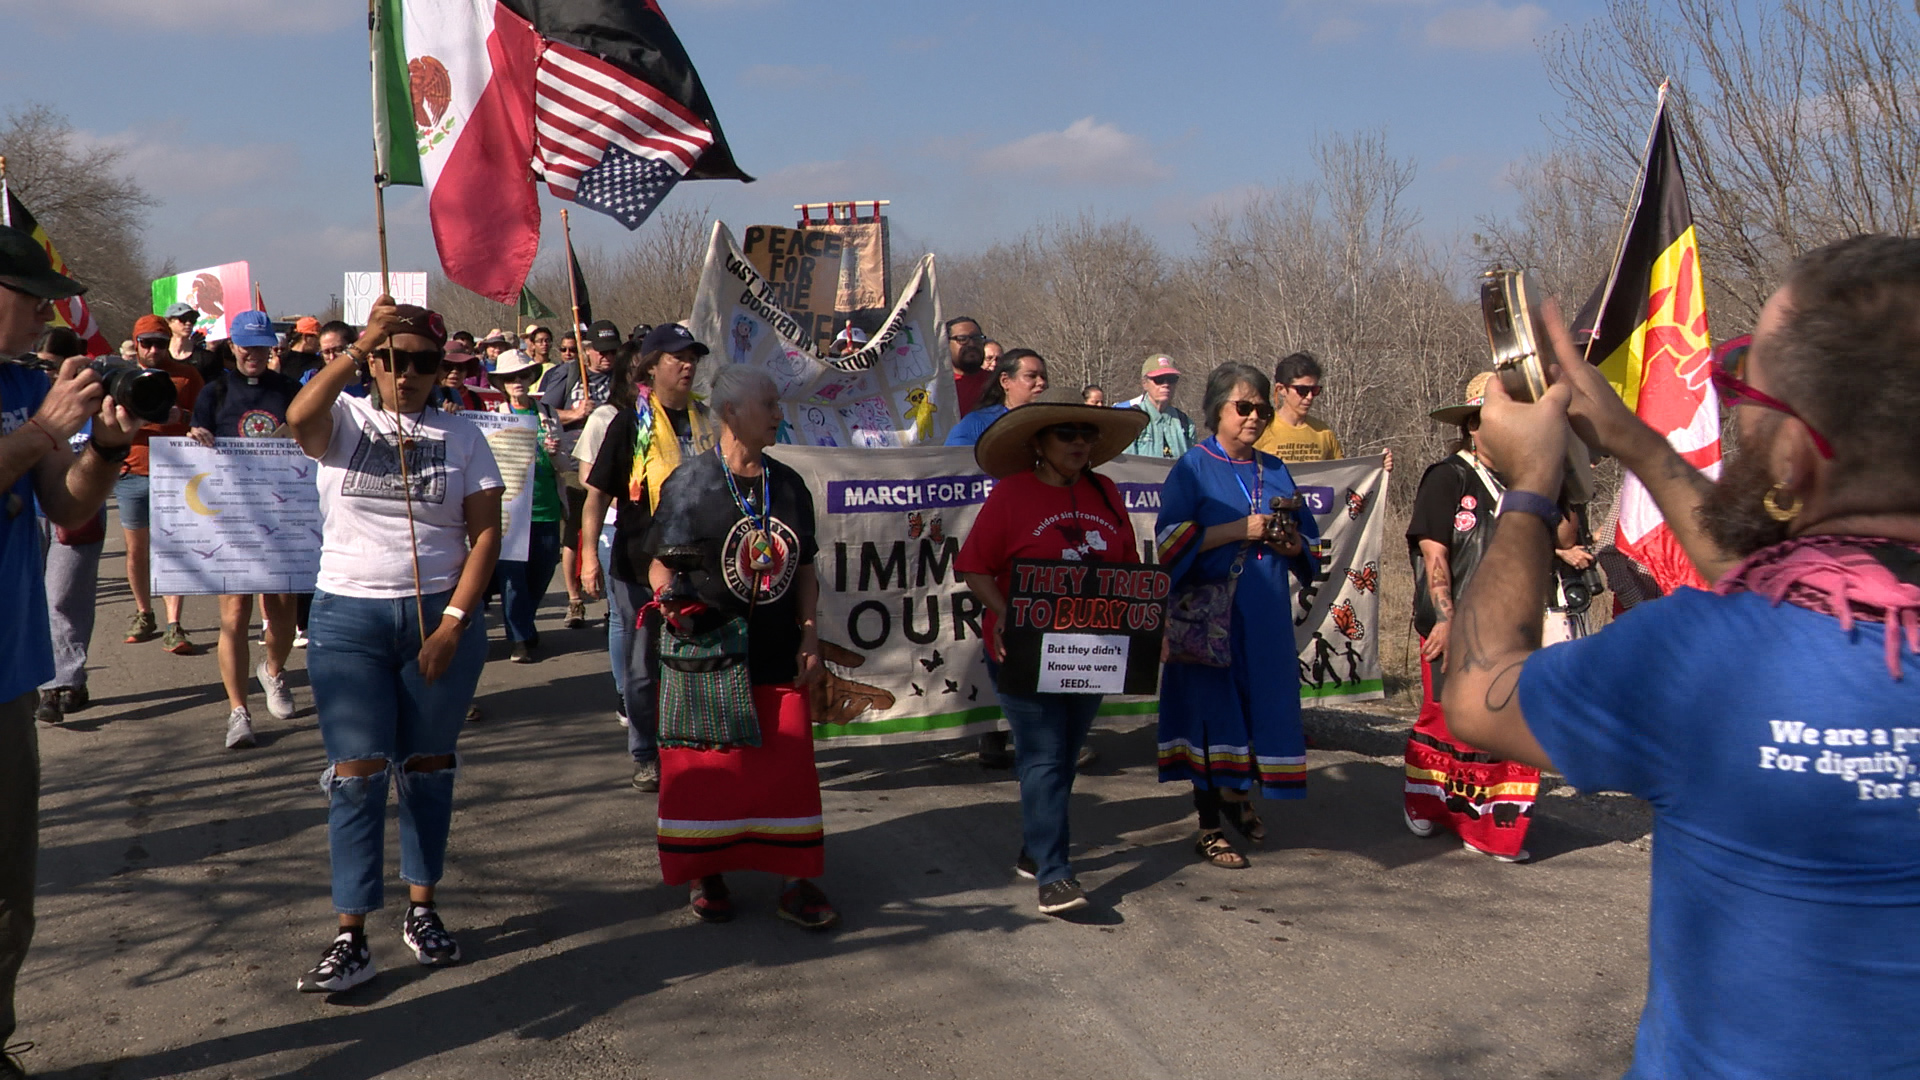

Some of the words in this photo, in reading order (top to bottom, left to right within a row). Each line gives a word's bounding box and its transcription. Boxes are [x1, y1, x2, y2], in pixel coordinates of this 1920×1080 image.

[744, 226, 843, 259] PEACE
[725, 253, 759, 287] LAST
[769, 253, 816, 284] FOR
[347, 272, 372, 297] NO
[379, 272, 424, 296] ATE
[766, 282, 810, 309] THE
[347, 297, 371, 325] NO
[740, 288, 798, 340] BOOKED
[844, 485, 923, 507] MARCH
[927, 482, 966, 502] FOR
[1032, 514, 1060, 537] Unidos
[1060, 511, 1074, 520] sin
[726, 557, 748, 598] NATIVE
[768, 552, 796, 598] NATIONS
[1016, 564, 1089, 595] THEY
[1096, 568, 1172, 600] TRIED
[847, 590, 984, 650] OUR
[1012, 597, 1052, 628] TO
[1053, 596, 1128, 630] BURY
[1126, 602, 1162, 631] US
[1047, 644, 1066, 654] But
[1068, 644, 1090, 656] they
[1092, 646, 1122, 656] didn't
[1048, 662, 1076, 672] Know
[1094, 664, 1118, 672] were
[1768, 719, 1820, 746] We
[1823, 728, 1868, 746] are
[1871, 728, 1890, 746] a
[1758, 746, 1811, 772] For
[1814, 749, 1918, 782] dignity,
[1857, 779, 1905, 801] For
